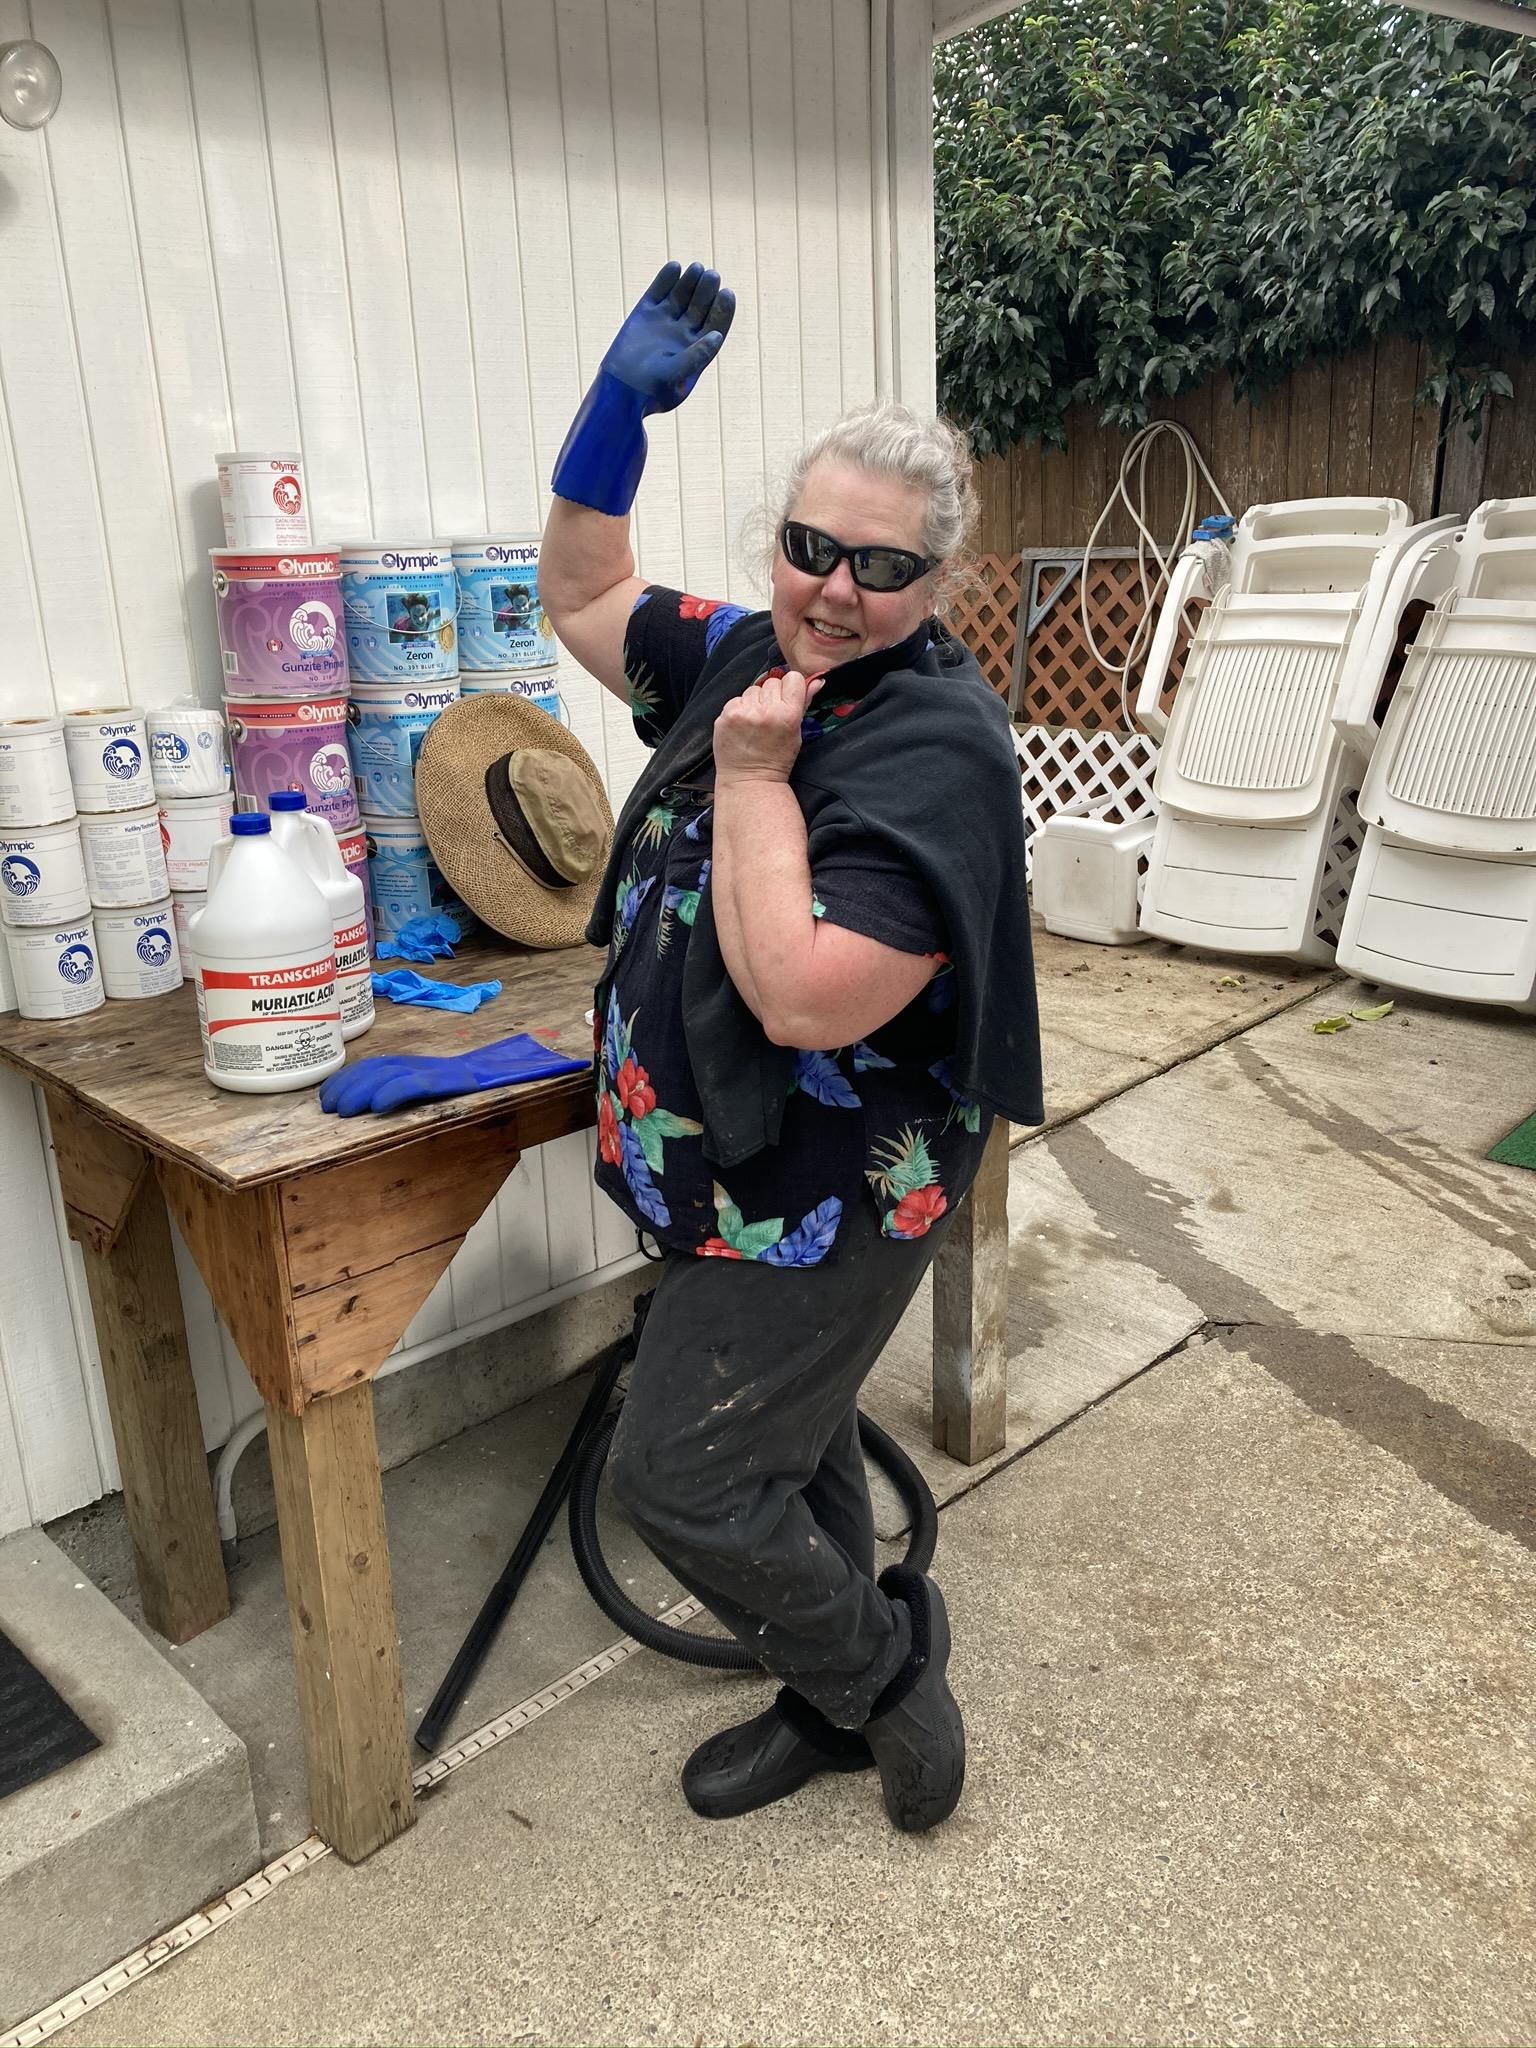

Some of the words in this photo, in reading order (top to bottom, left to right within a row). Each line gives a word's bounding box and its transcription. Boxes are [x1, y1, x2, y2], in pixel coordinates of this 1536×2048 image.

[381, 552, 439, 571] Olympic
[485, 544, 538, 563] Olympic
[278, 557, 334, 578] Olympic
[509, 639, 535, 649] Zeron
[406, 651, 433, 661] Zeron
[281, 661, 322, 673] Gunzite
[510, 677, 555, 697] Olympic
[404, 690, 455, 709] Olympic
[297, 701, 347, 723] Olympic
[99, 722, 137, 737] Olympic
[151, 733, 175, 747] Pool
[133, 912, 168, 927] Olympic
[55, 928, 89, 944] Olympic
[336, 948, 366, 968] URIATIC
[248, 960, 332, 987] TRANSCHEM
[251, 991, 316, 1012] MURIATIC
[316, 983, 335, 1002] ACID
[265, 1044, 293, 1052] DANGER
[316, 1031, 333, 1042] POISON
[303, 1059, 318, 1067] GALLON
